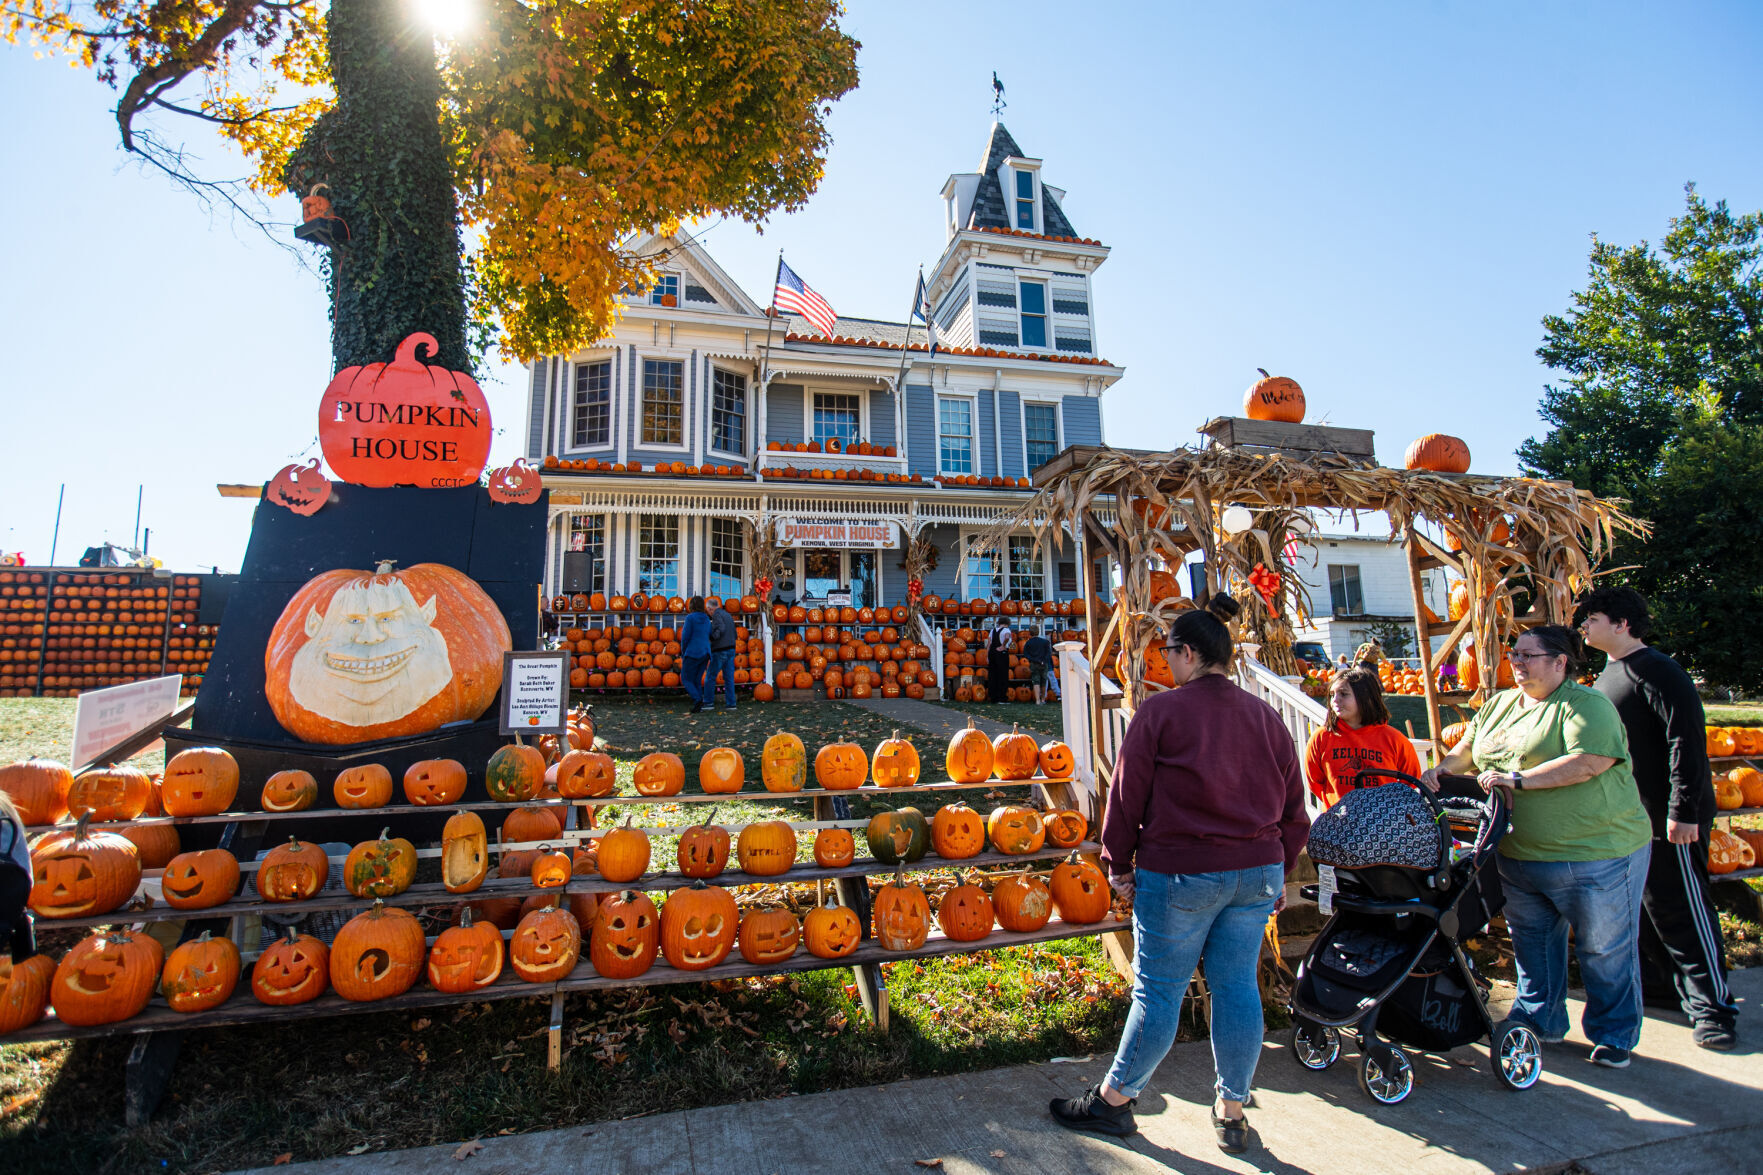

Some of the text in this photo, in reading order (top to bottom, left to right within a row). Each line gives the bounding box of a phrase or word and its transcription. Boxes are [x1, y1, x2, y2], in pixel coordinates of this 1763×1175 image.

[334, 401, 481, 428] PUMPKIN
[350, 437, 459, 462] HOUSE
[785, 525, 890, 541] PUMPKIN HOUSE
[1332, 748, 1383, 763] KELLOGG
[1337, 775, 1379, 787] TIGRS
